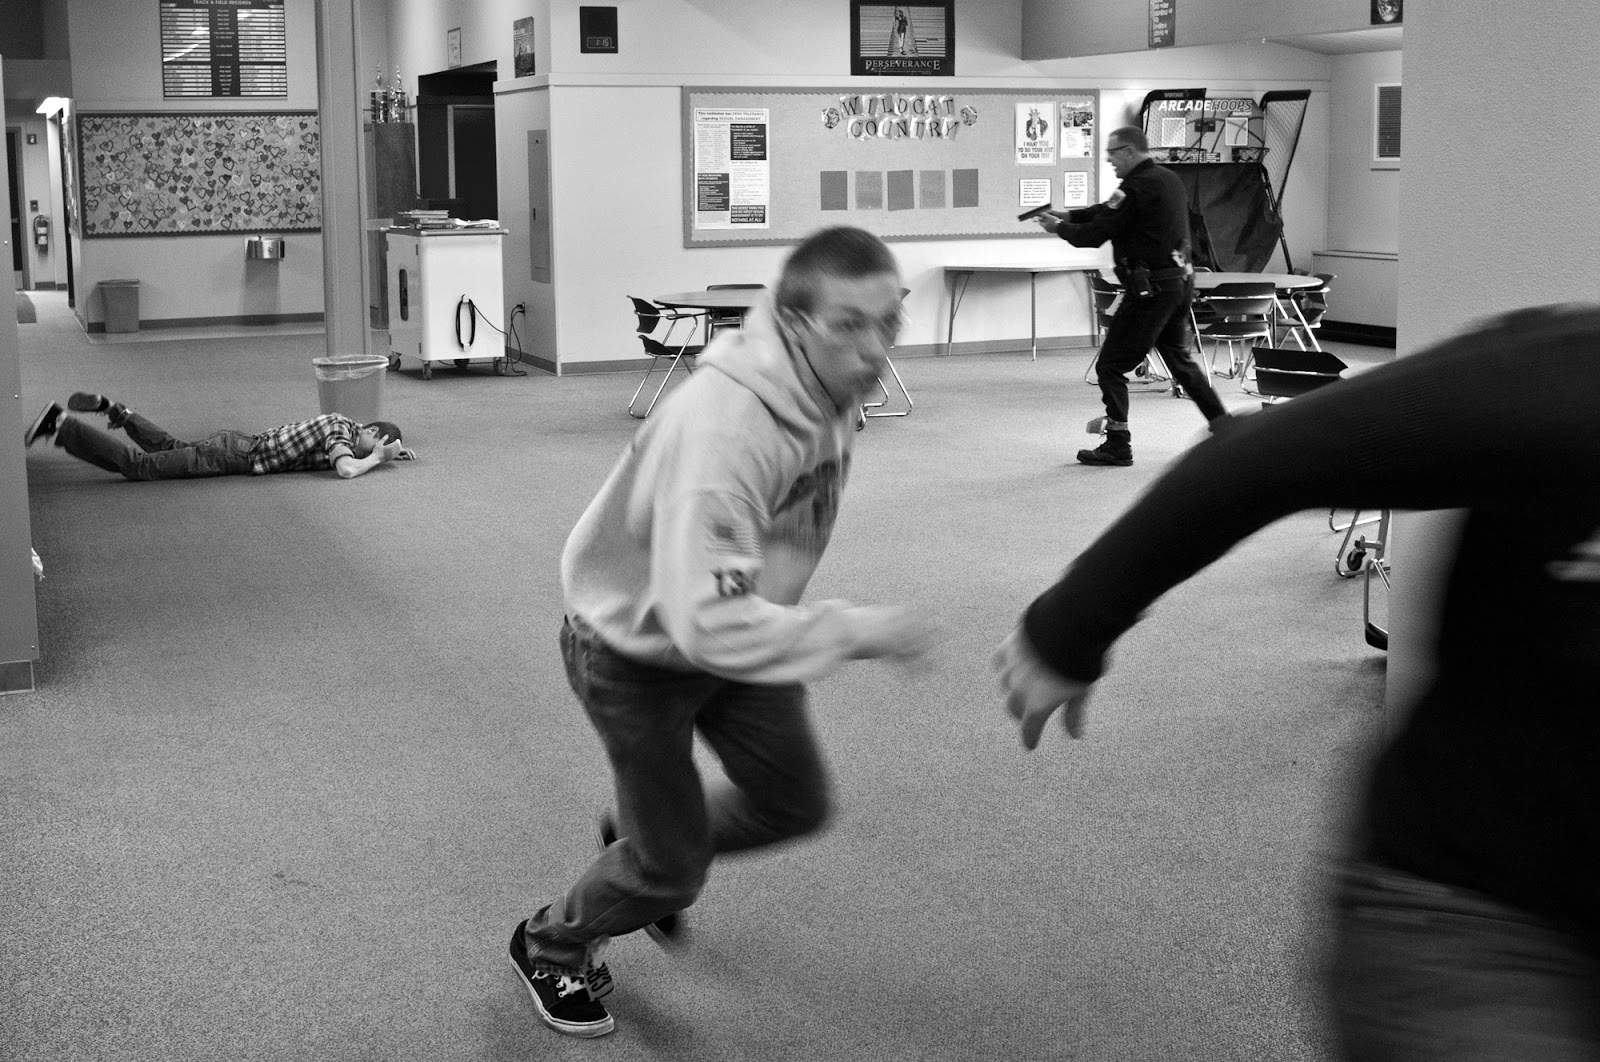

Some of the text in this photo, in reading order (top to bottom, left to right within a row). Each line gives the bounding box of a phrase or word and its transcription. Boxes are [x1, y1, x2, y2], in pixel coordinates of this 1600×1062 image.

[865, 59, 941, 70] PERSEVERANCE
[842, 95, 954, 116] WILDCAT
[850, 119, 960, 138] COUNTRY
